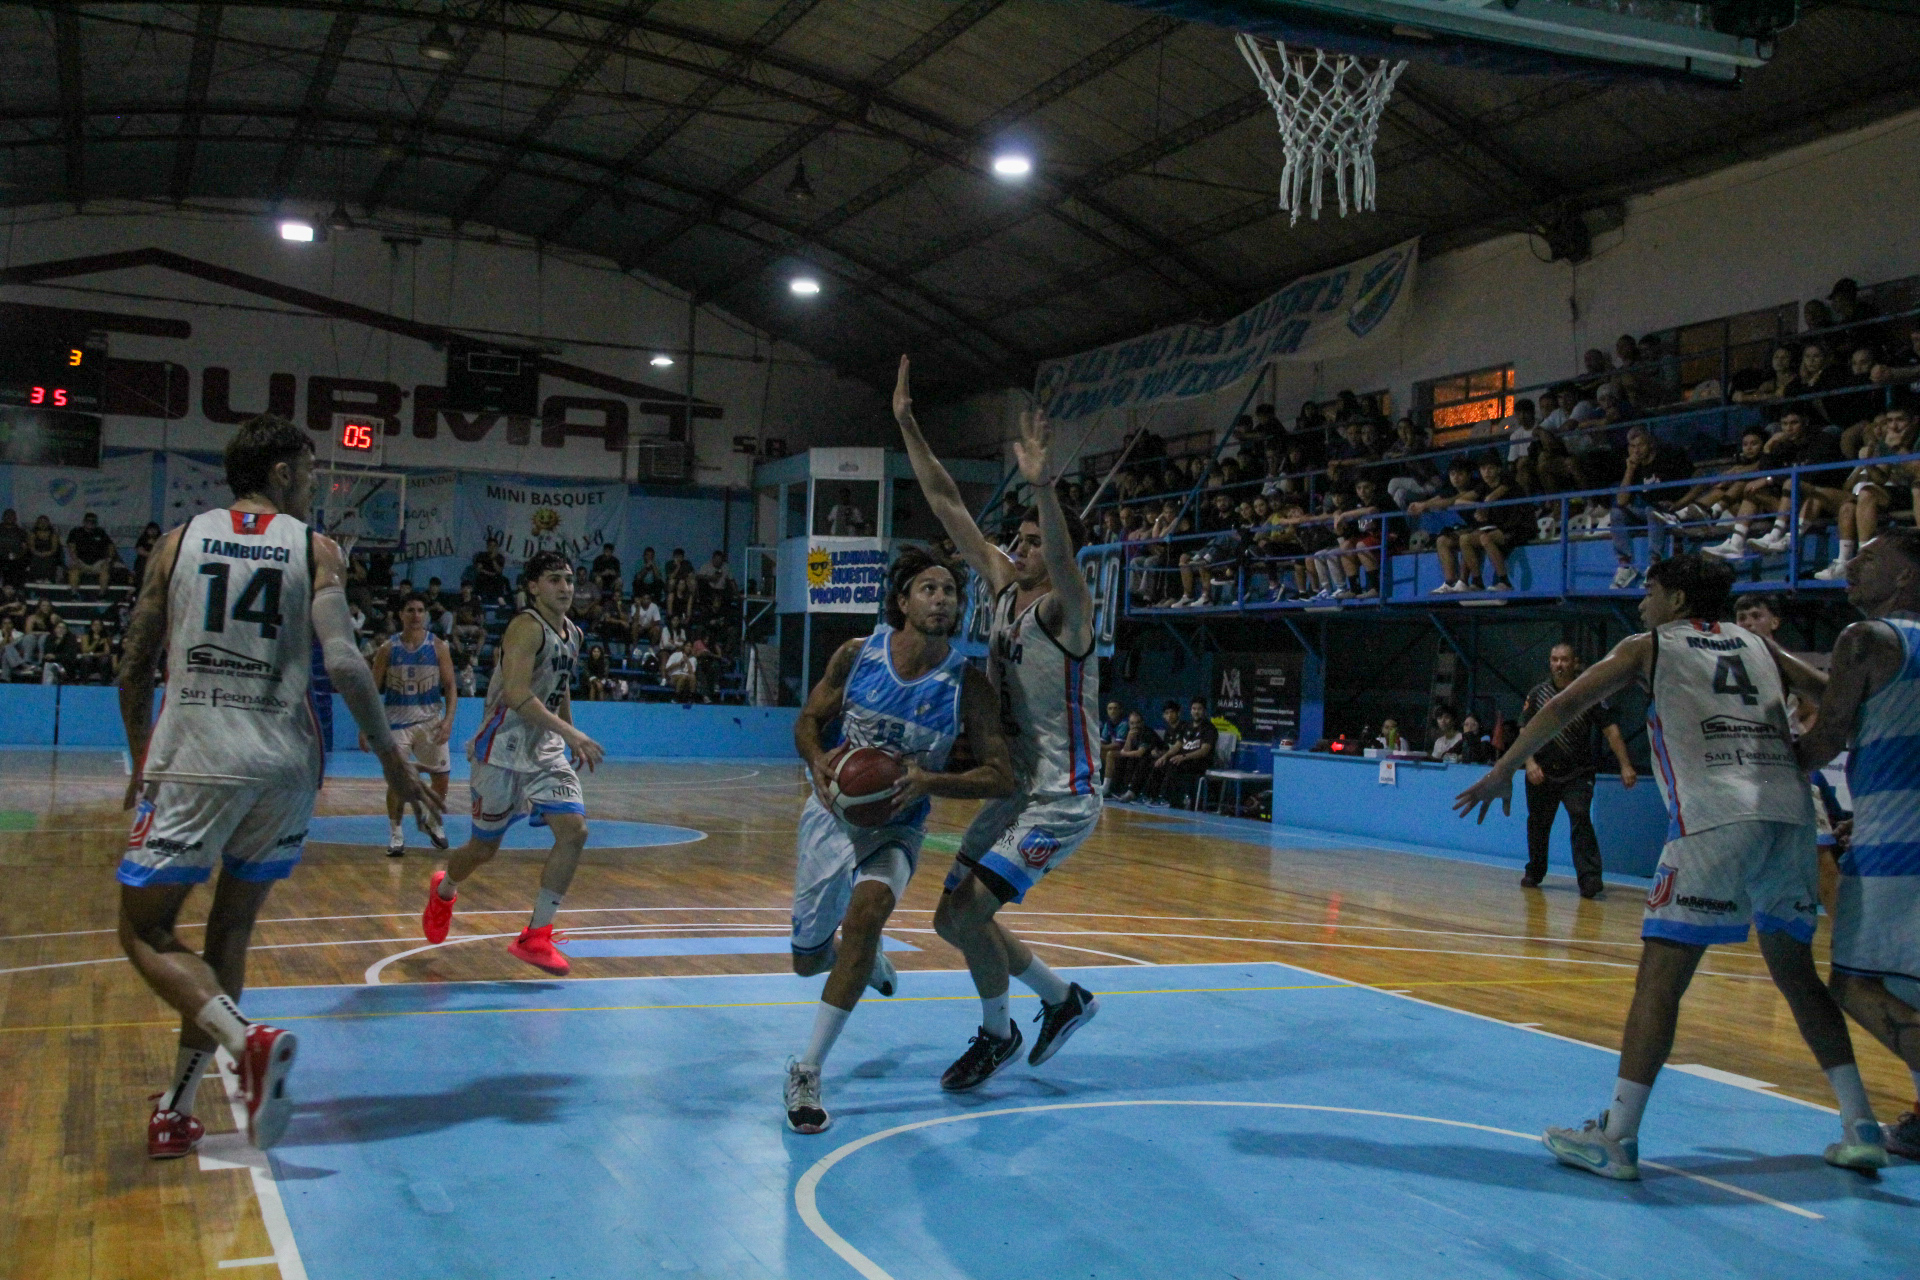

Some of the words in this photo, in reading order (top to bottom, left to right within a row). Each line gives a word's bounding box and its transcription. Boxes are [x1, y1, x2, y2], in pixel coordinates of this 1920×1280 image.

[69, 349, 83, 367] 3
[343, 424, 373, 449] 05
[487, 485, 526, 504] MINI
[531, 491, 605, 508] BASQUET
[202, 538, 290, 563] TAMBUCCI
[485, 525, 515, 554] SOL
[200, 562, 284, 640] 14
[809, 585, 853, 605] PROPIO
[1712, 654, 1759, 706] 4
